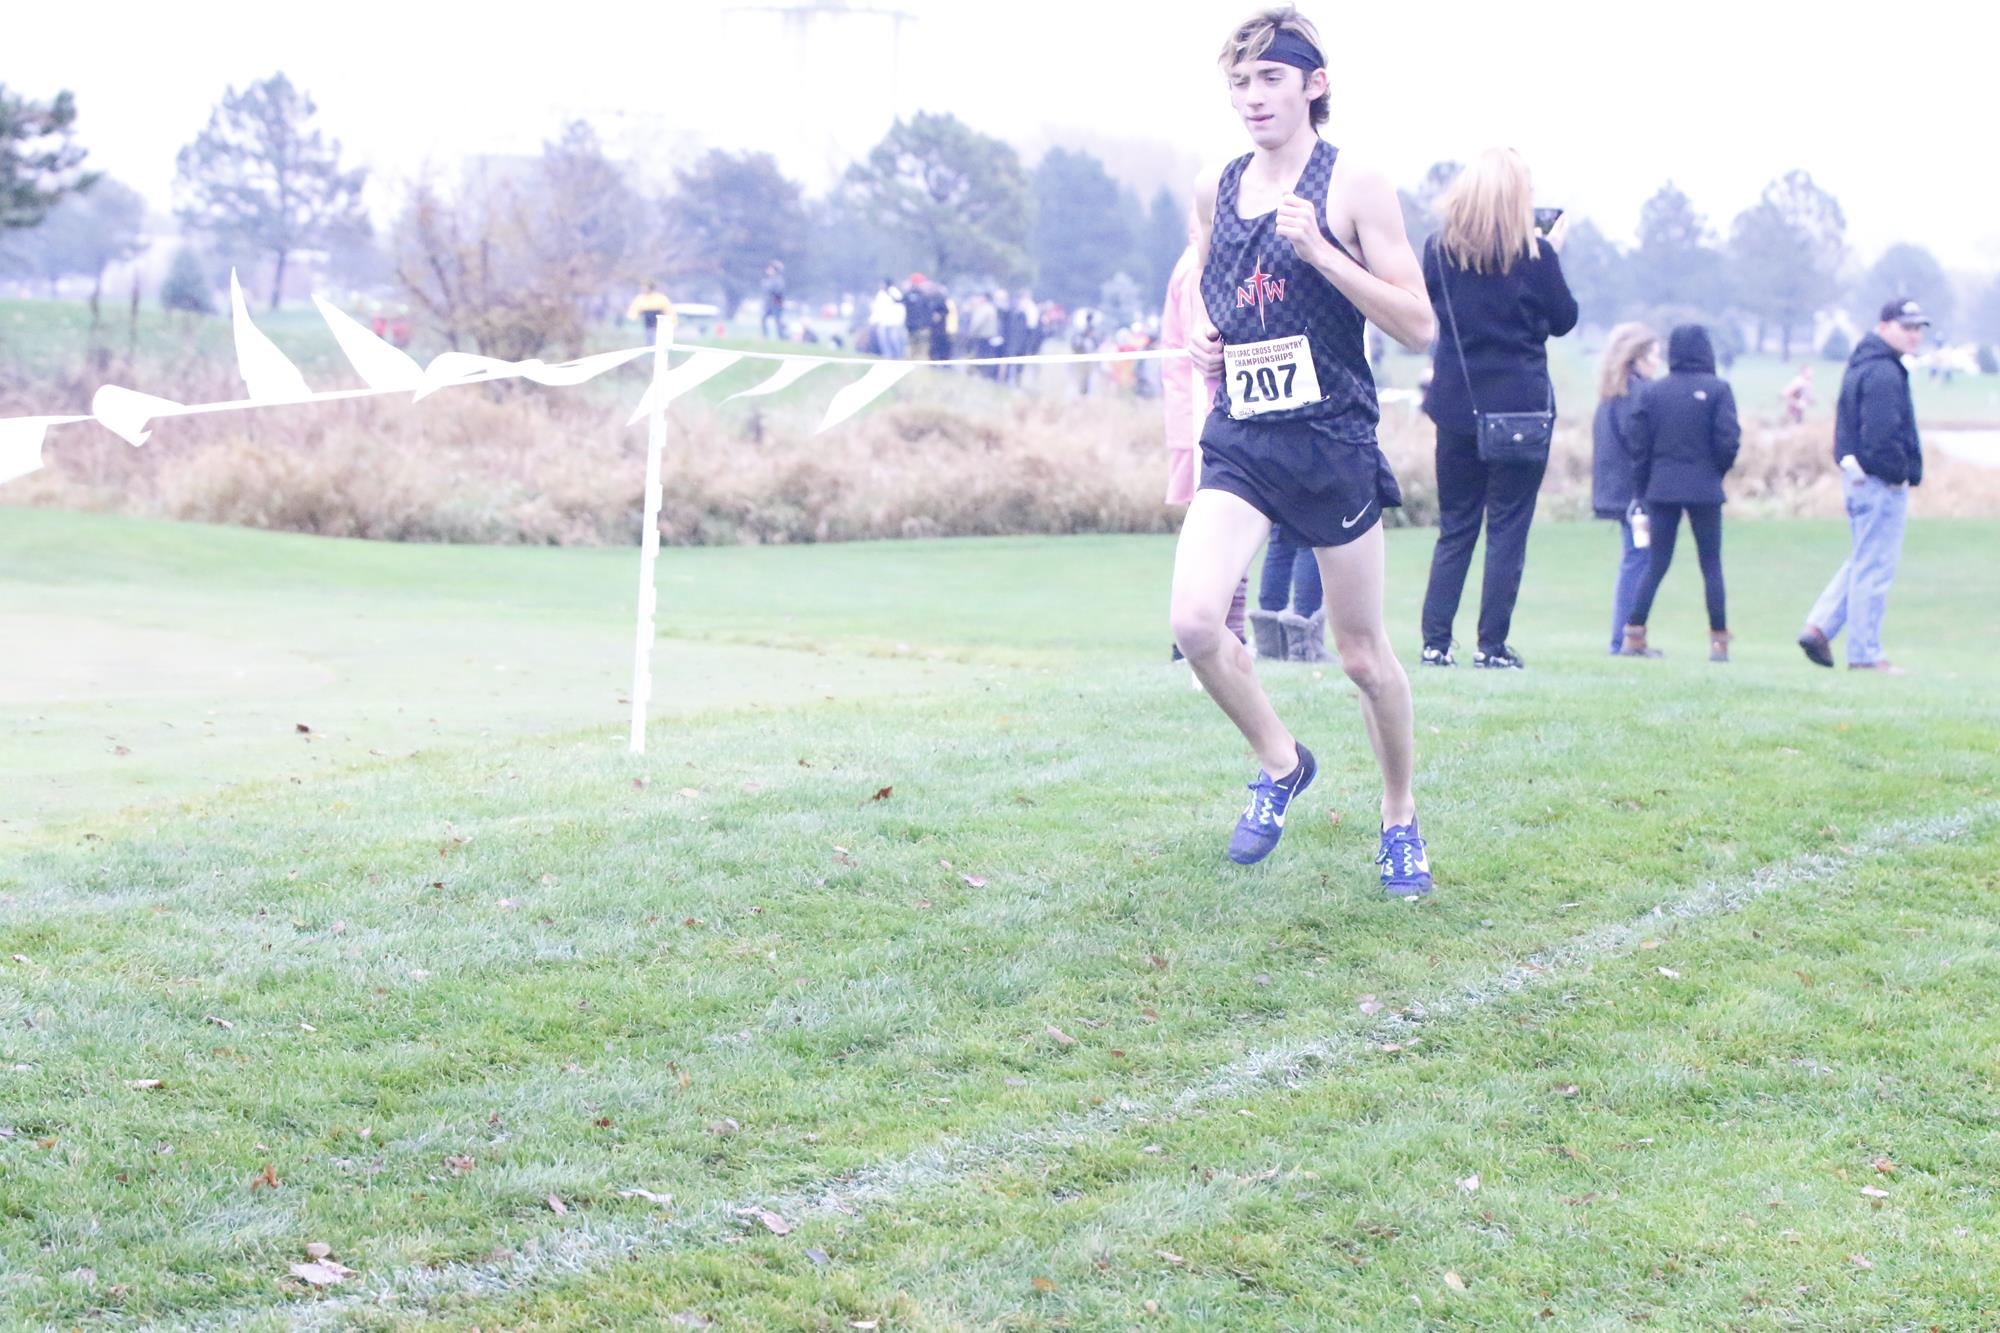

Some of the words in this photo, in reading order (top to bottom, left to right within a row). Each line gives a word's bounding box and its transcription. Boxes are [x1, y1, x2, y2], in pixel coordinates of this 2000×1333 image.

[1252, 346, 1271, 356] CROSS
[1273, 340, 1302, 352] COUNTRY
[1235, 352, 1294, 367] CHAMPIONSHIPS
[1236, 363, 1297, 403] 207
